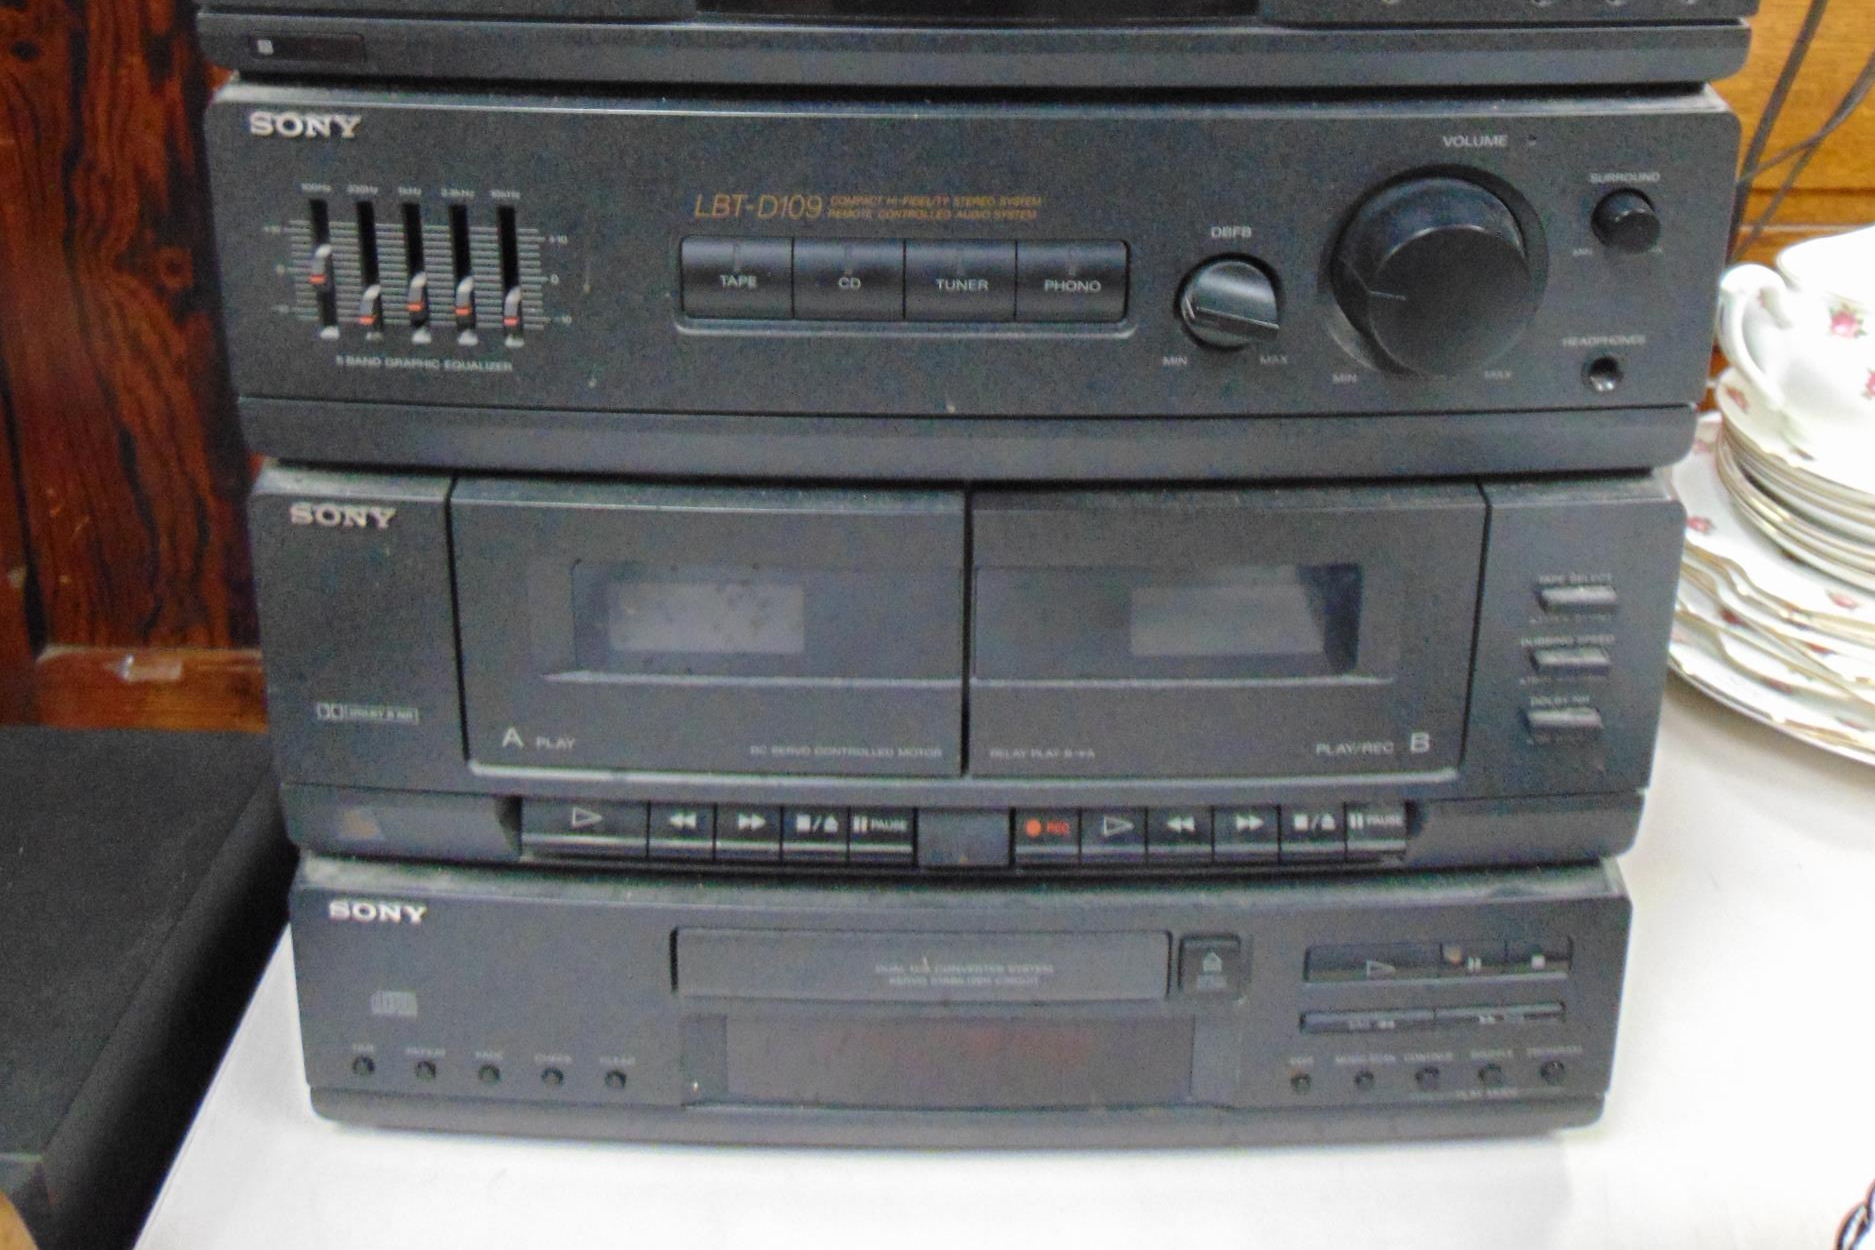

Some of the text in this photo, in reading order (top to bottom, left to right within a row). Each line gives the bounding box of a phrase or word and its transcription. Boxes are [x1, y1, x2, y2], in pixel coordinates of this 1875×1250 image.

[250, 111, 361, 139] SONY
[1442, 135, 1508, 148] VOLUME
[694, 193, 822, 220] LBT-D109
[1210, 225, 1252, 239] DBFB
[720, 274, 757, 290] TAPE
[837, 276, 861, 290] CD
[935, 277, 989, 292] TUNER
[1044, 279, 1101, 293] PHONO
[1162, 356, 1188, 366] MIN
[289, 501, 398, 531] SONY
[502, 727, 576, 750] A PLAY
[1316, 731, 1430, 755] PLAY/REC B
[870, 818, 907, 832] PAUSE
[328, 900, 428, 925] SONY
